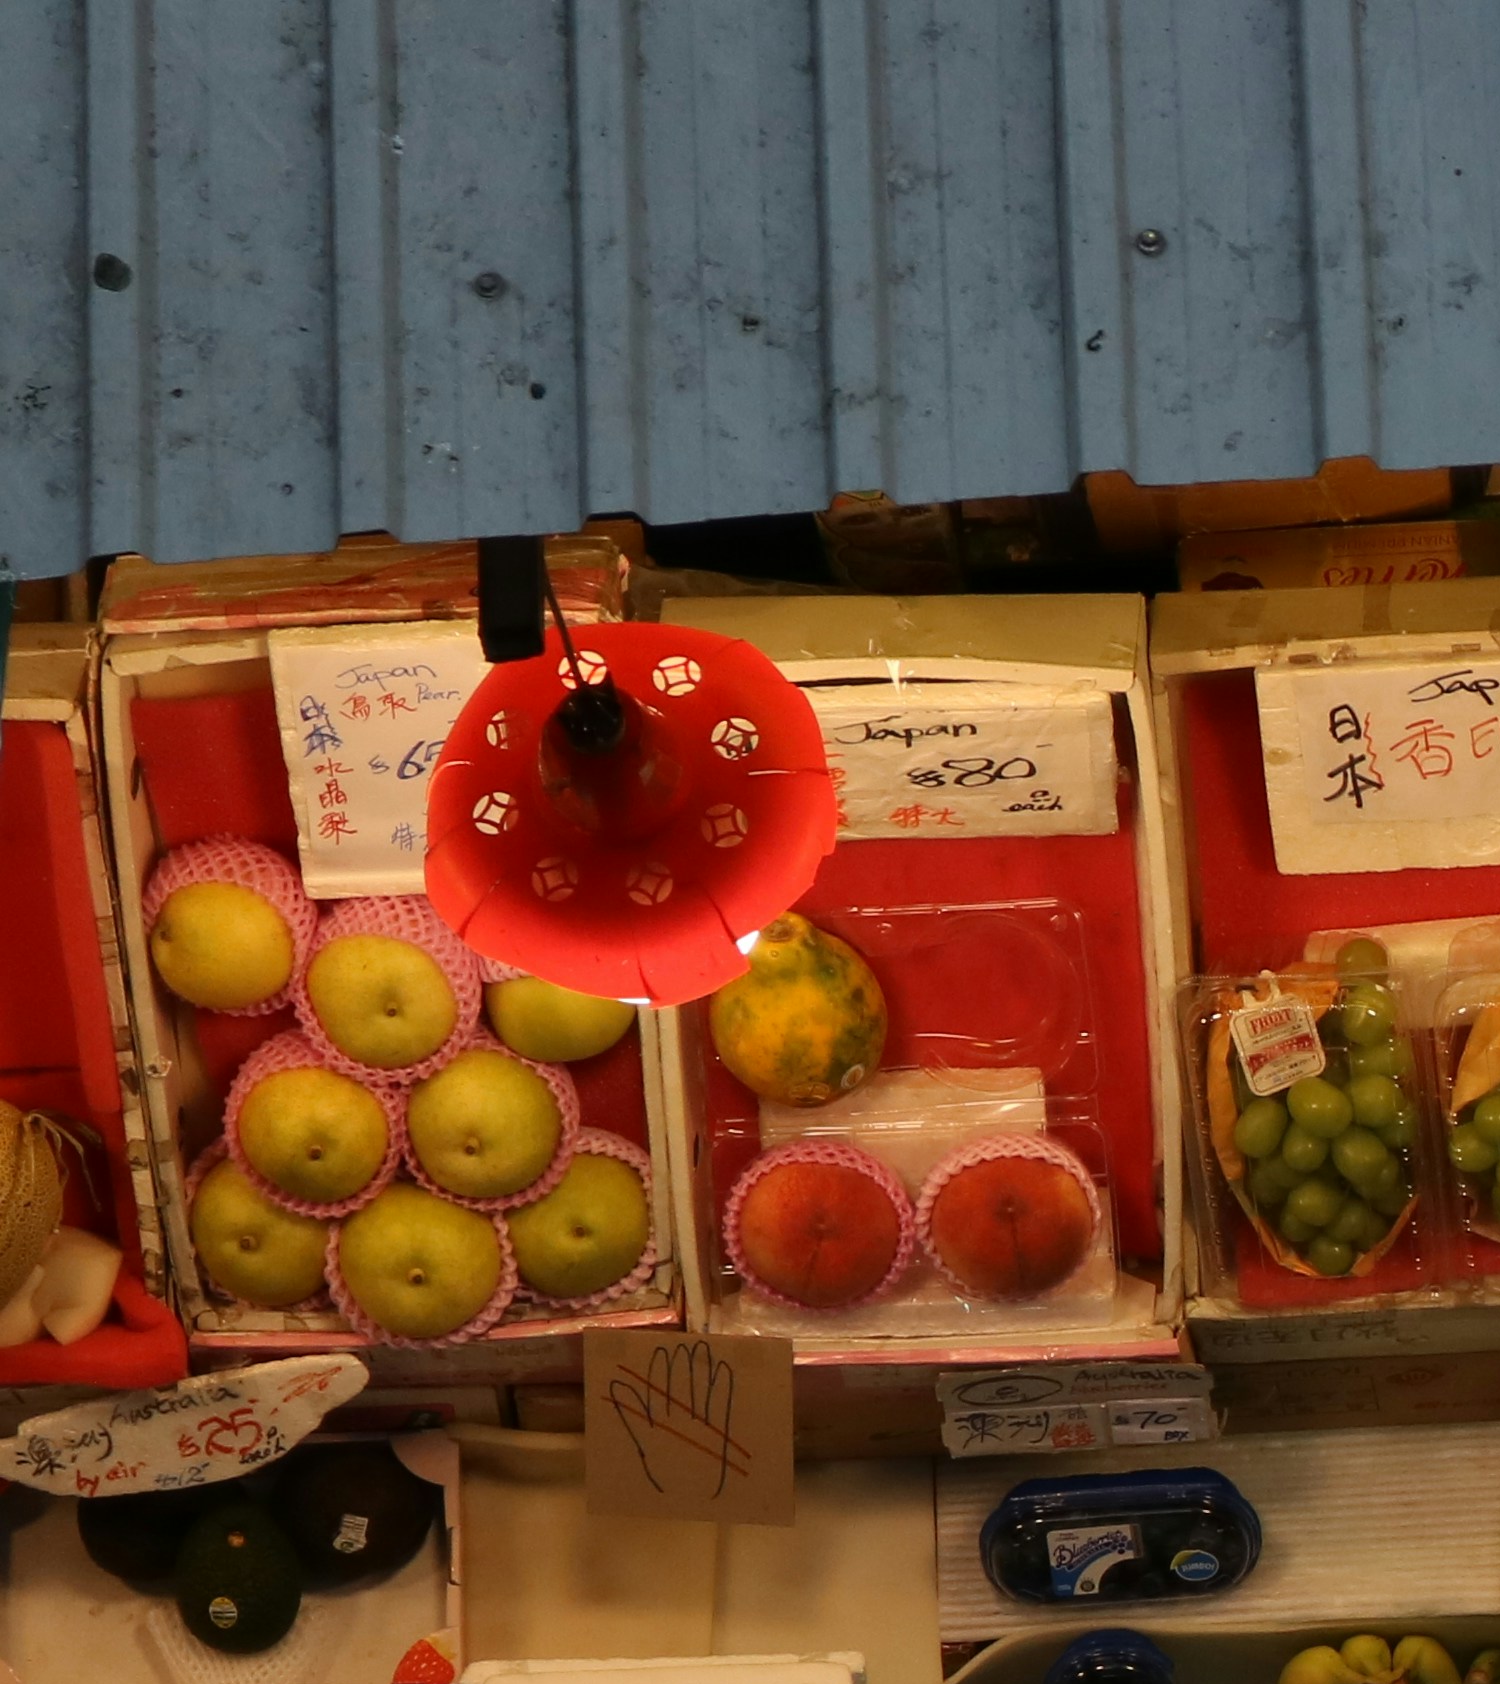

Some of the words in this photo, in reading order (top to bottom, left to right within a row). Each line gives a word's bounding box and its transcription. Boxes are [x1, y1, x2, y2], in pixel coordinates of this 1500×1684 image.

[335, 663, 437, 691] Japan
[834, 713, 978, 749] Japan
[1322, 703, 1385, 808] 日本
